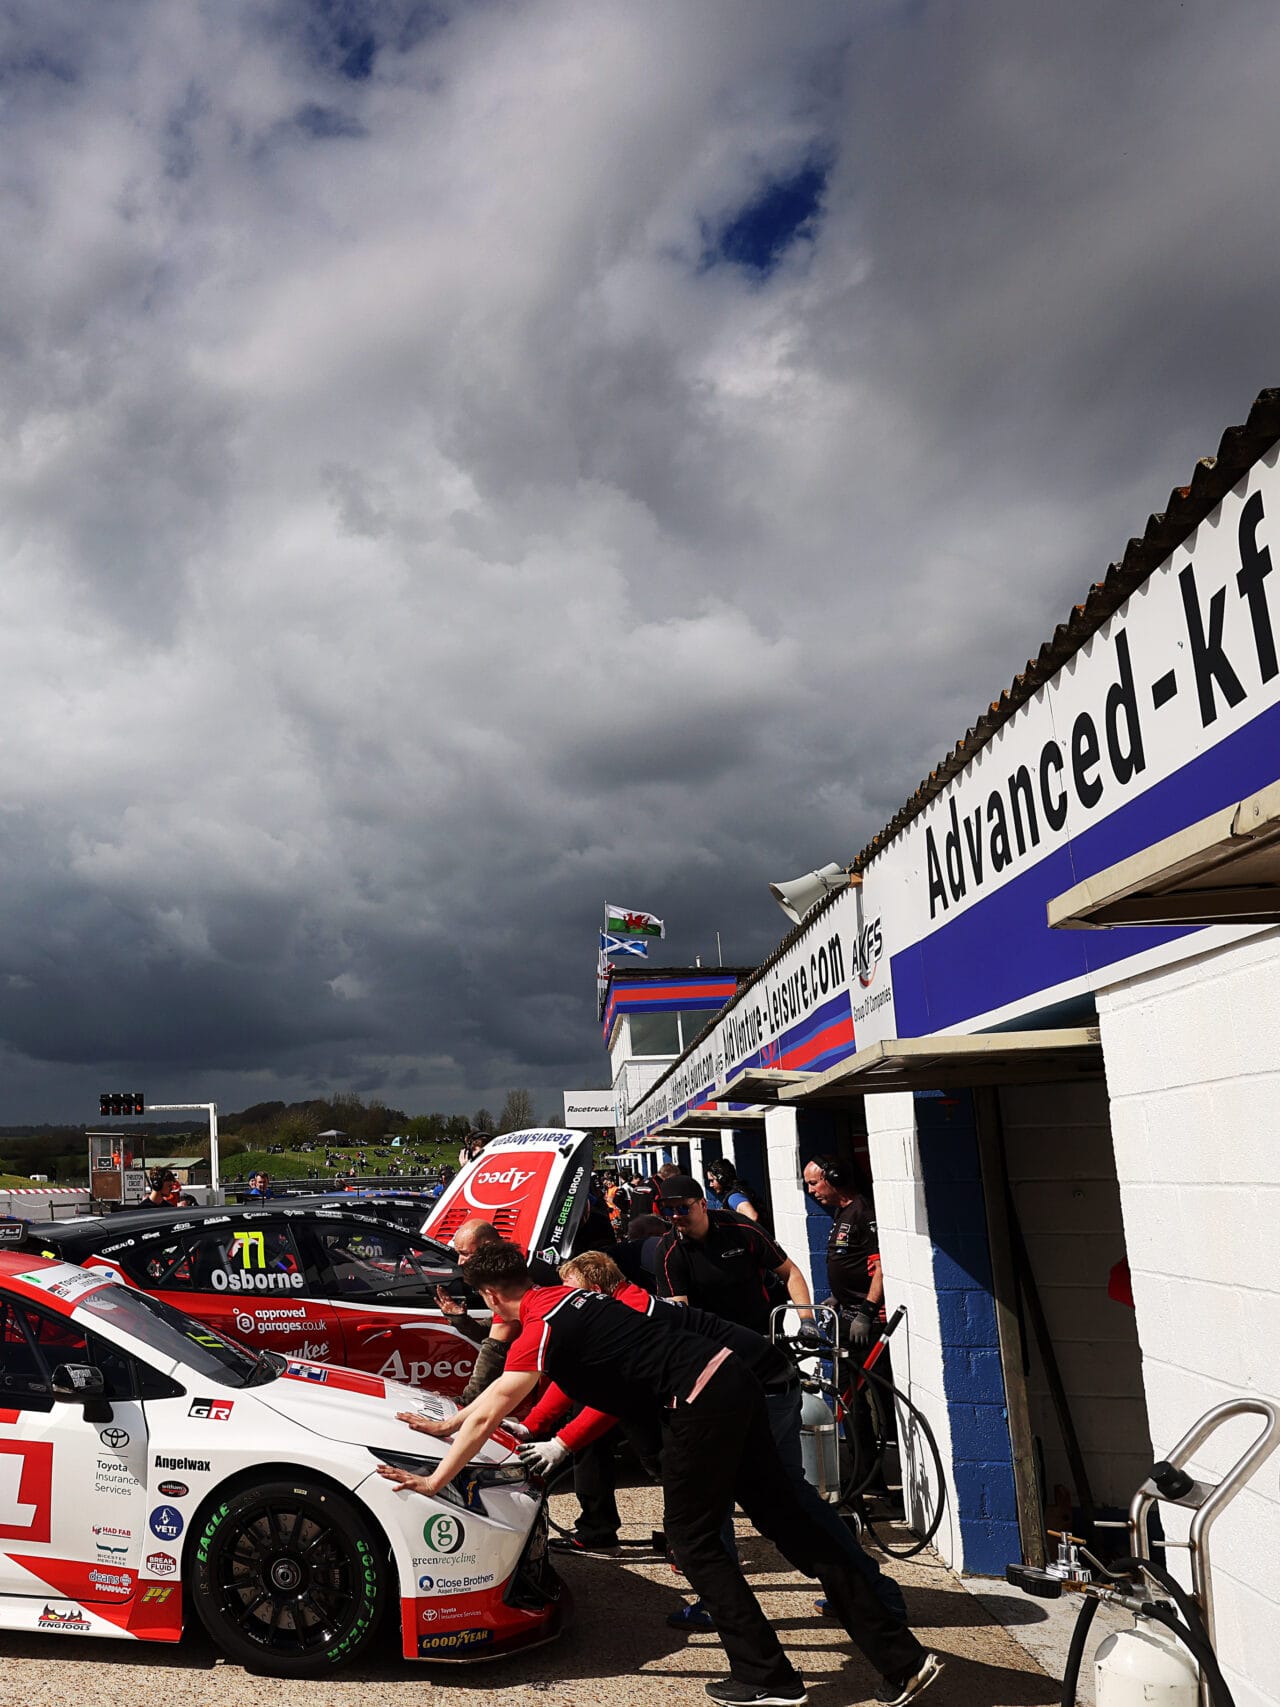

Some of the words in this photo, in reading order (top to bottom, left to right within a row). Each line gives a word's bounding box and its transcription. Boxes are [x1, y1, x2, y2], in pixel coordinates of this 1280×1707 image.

[568, 1166, 585, 1196] GROUP
[557, 1194, 575, 1225] GREEN
[551, 1223, 565, 1243] THE
[233, 1231, 266, 1269] 77
[211, 1269, 304, 1290] Osborne
[255, 1307, 306, 1320] approved
[257, 1320, 327, 1334] garages.co.uk
[189, 1405, 232, 1420] GR
[96, 1460, 128, 1472] Toyota
[154, 1455, 211, 1472] Angelwax
[95, 1471, 140, 1485] Insurance
[95, 1483, 132, 1495] Services
[102, 1526, 118, 1534] HAD
[118, 1528, 132, 1537] FAB
[155, 1525, 178, 1533] YETI
[196, 1502, 230, 1563] EAGLE
[149, 1556, 174, 1565] BREAK
[150, 1563, 172, 1571] FLUID
[412, 1553, 476, 1567] greenrecycling
[89, 1570, 120, 1585] deans
[436, 1578, 462, 1588] Close
[463, 1574, 494, 1586] Brothers
